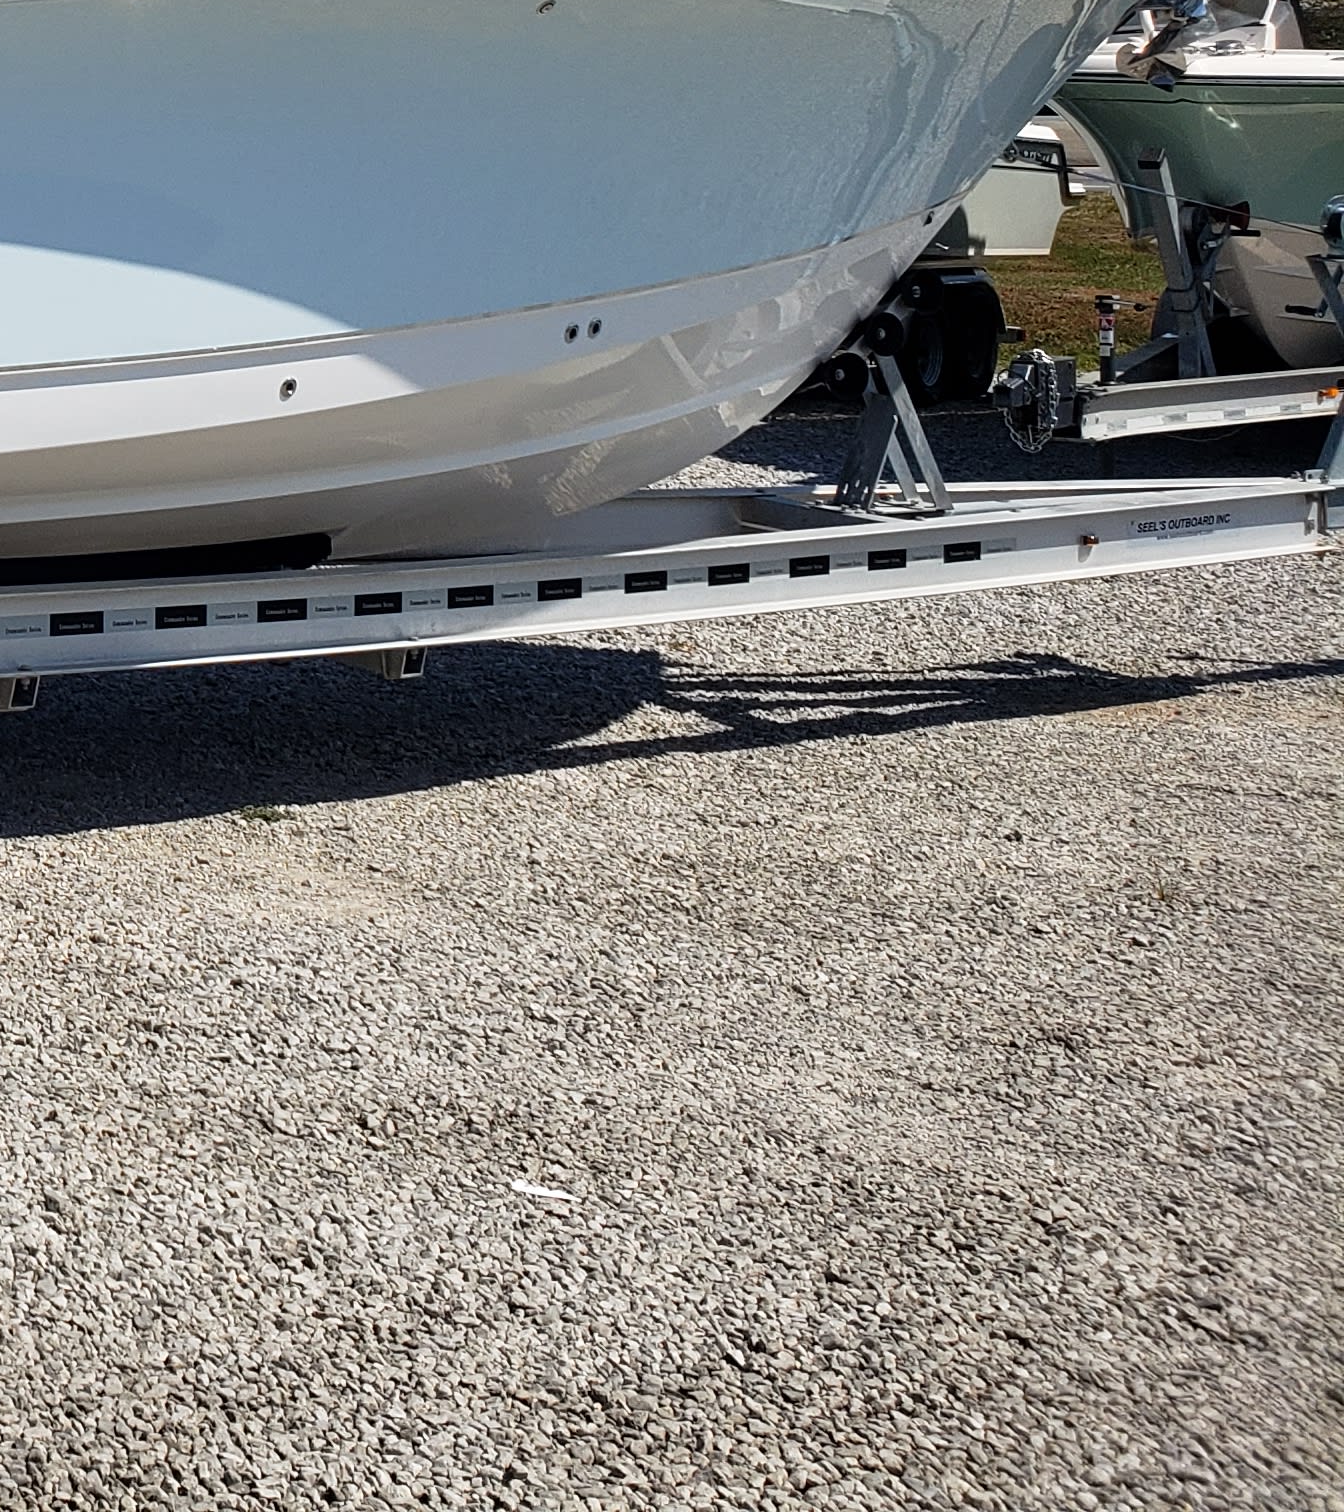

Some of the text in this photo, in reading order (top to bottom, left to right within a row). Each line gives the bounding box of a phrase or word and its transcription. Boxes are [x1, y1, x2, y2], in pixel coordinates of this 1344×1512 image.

[1137, 513, 1231, 534] SEEL'S OUTBOARD INC
